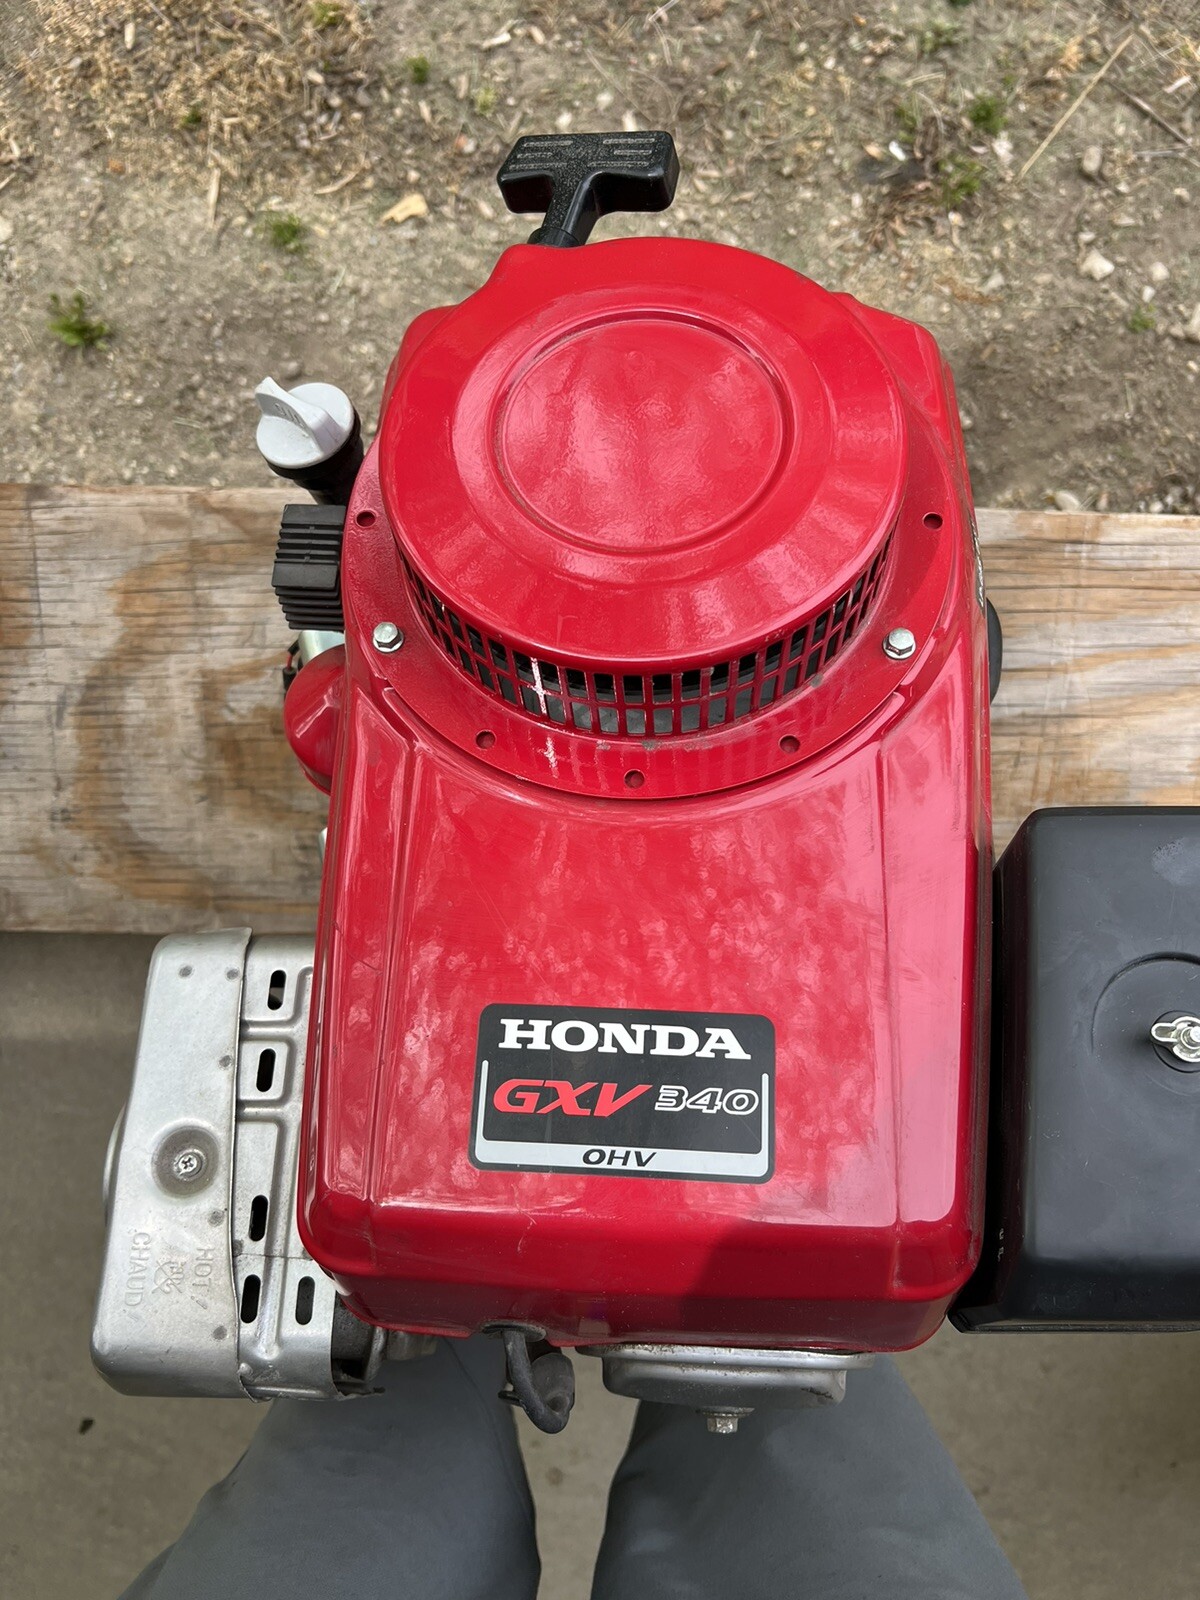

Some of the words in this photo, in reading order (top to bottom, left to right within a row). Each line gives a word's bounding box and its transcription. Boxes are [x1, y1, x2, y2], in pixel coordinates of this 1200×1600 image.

[498, 1018, 752, 1060] HONDA
[493, 1078, 654, 1118] GXV
[654, 1085, 759, 1116] 340
[582, 1148, 657, 1168] OHV
